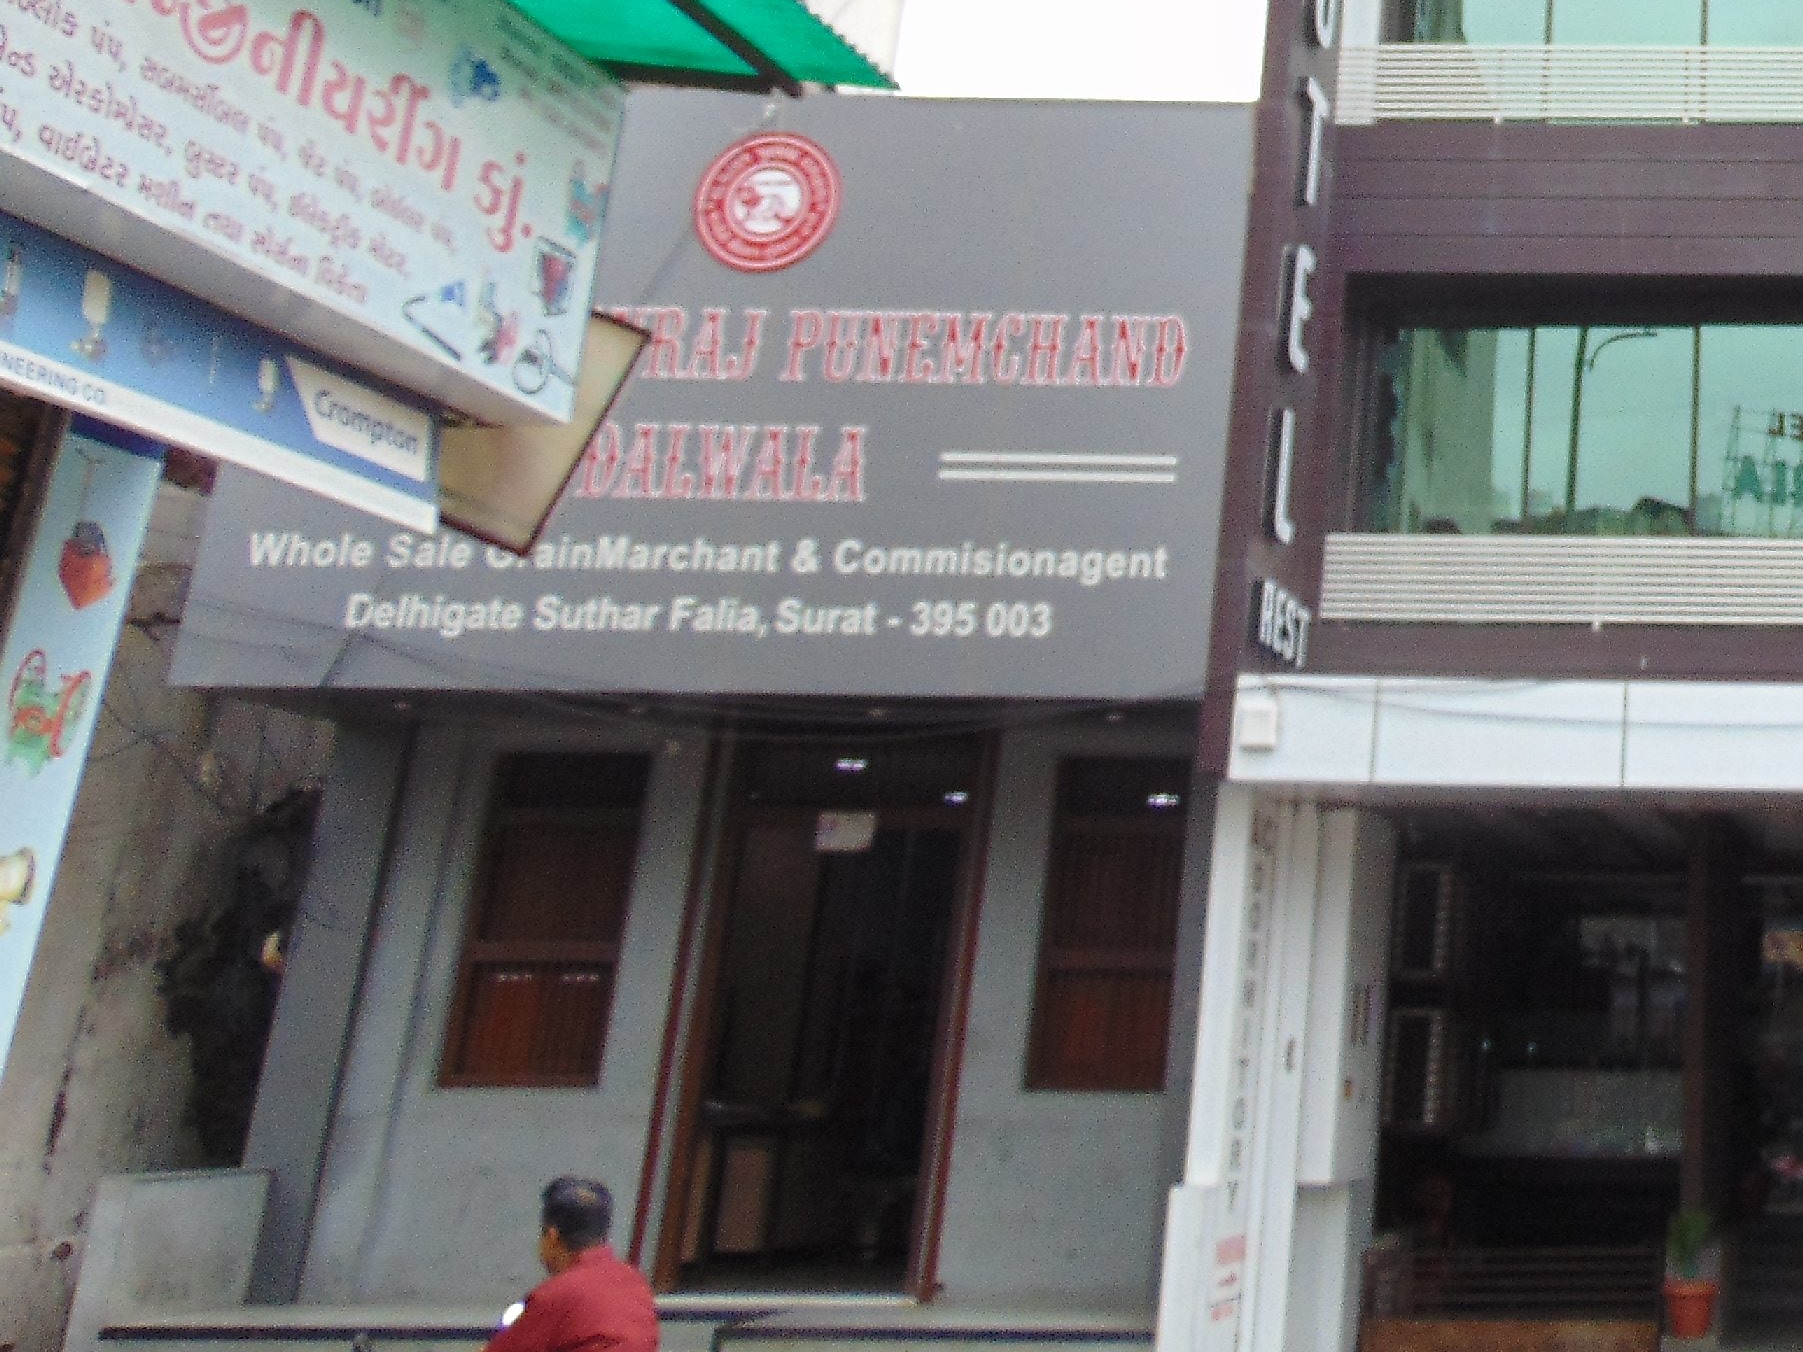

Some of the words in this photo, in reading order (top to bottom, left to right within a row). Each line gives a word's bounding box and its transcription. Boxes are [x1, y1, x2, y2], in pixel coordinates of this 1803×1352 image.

[778, 309, 1189, 388] PUNEMCHAND
[575, 420, 868, 503] DALWALA
[248, 533, 373, 569] Whole
[385, 533, 473, 569] Sale
[791, 538, 820, 574] &
[833, 538, 1169, 587] Commisionagent
[343, 593, 526, 639] Delhigate
[532, 594, 662, 631] Suthar
[775, 598, 878, 635] Surat
[909, 601, 978, 637] 395
[986, 602, 1054, 638] 003
